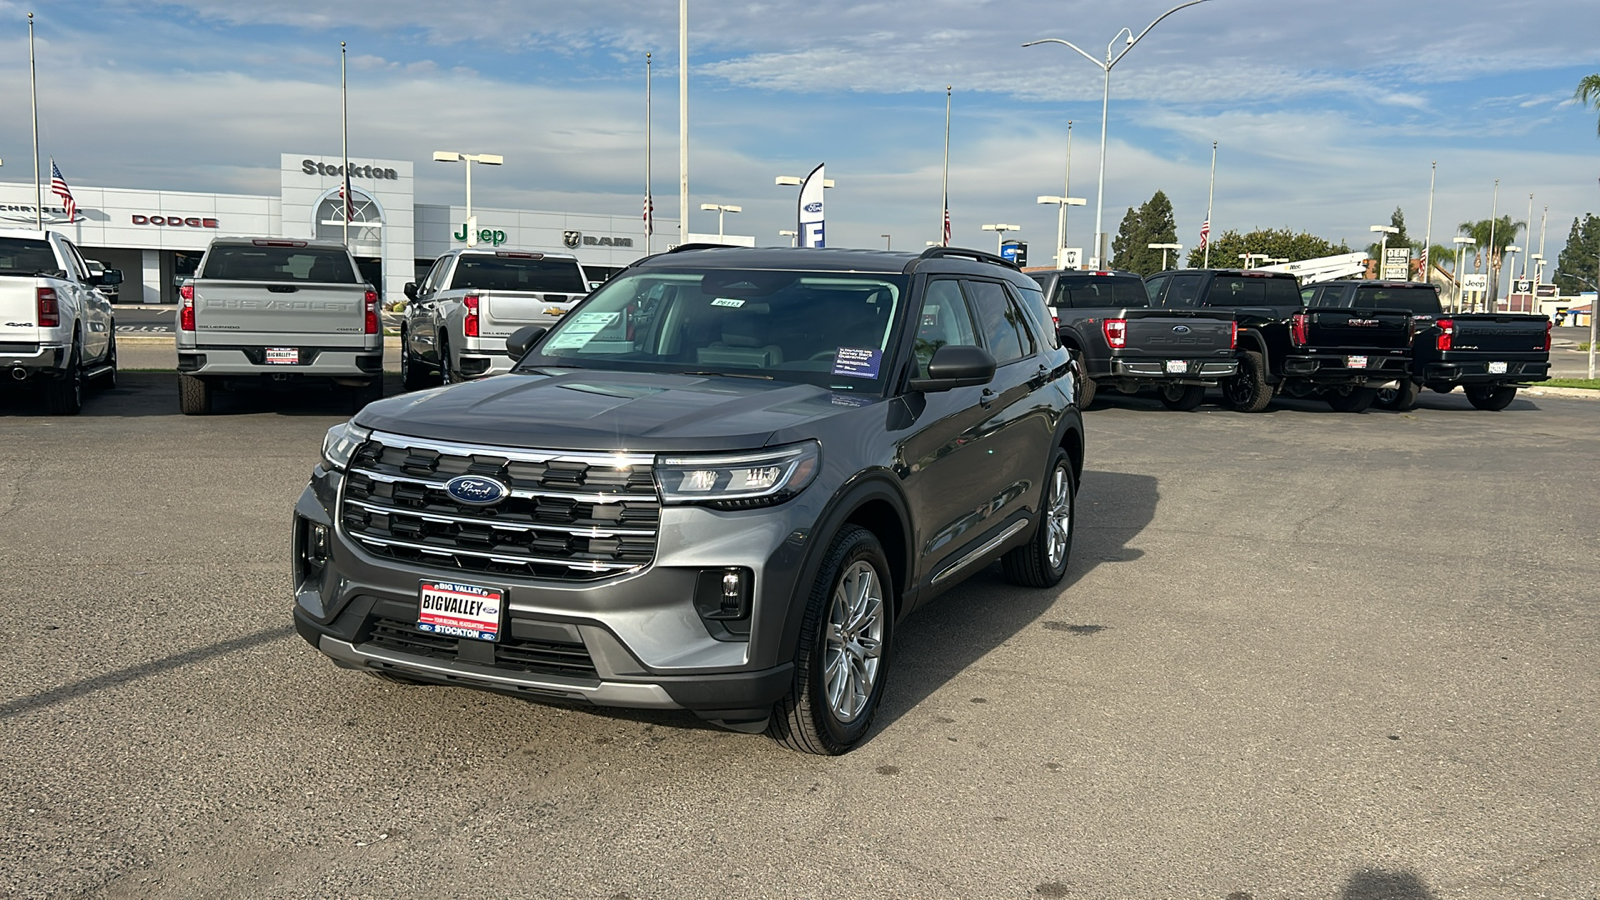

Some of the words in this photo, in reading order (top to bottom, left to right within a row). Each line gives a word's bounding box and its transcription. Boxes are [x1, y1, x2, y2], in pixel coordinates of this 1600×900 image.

[302, 159, 398, 180] Stockton
[132, 215, 219, 228] DODGE
[454, 223, 507, 247] Jep
[583, 236, 633, 247] RAM
[1387, 249, 1407, 258] OEM
[1465, 280, 1485, 288] Jeep
[206, 300, 355, 311] CHEVROLET
[458, 480, 491, 498] Ford
[439, 583, 453, 591] BIG
[454, 585, 482, 594] VALLEY
[423, 594, 483, 616] BIGVALLEY
[434, 625, 480, 638] STOCKTON
